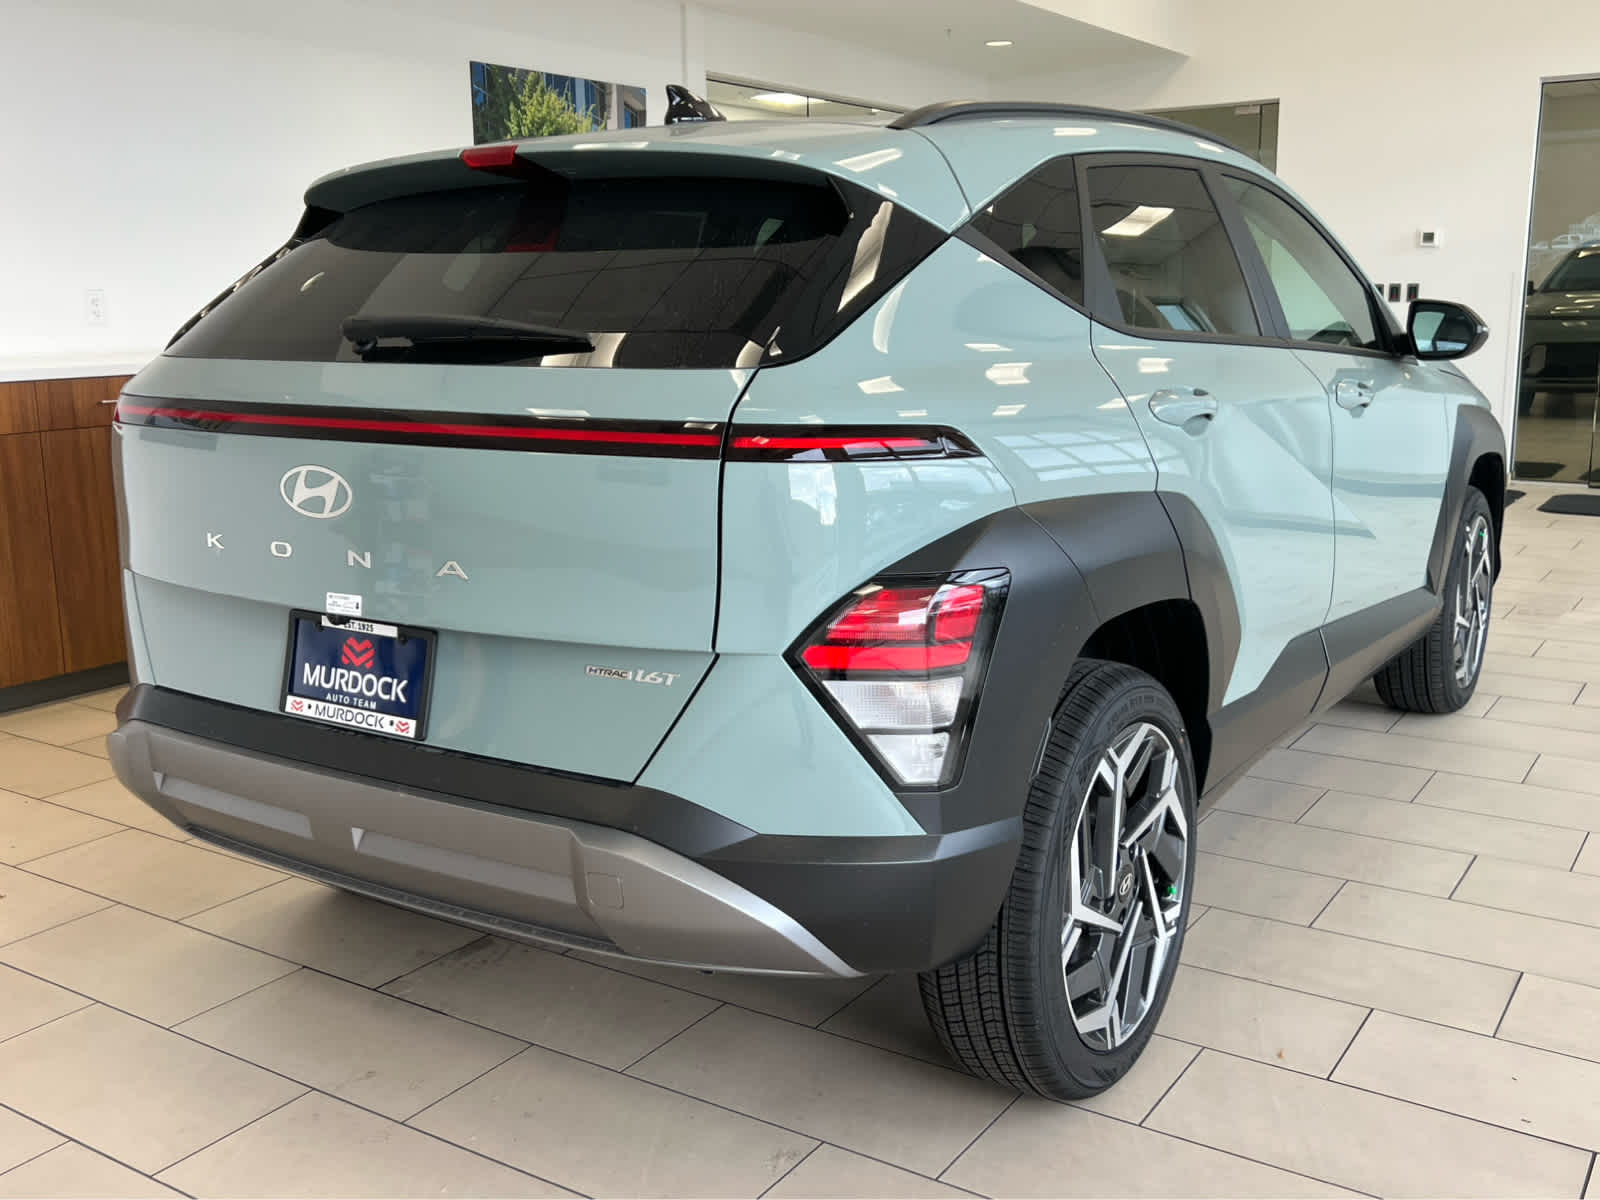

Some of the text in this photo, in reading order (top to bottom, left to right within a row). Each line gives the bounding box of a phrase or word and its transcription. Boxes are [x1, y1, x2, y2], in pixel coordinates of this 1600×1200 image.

[303, 662, 408, 703] MURDOCK
[586, 666, 630, 680] HTRAC
[326, 693, 377, 710] AUTO TEAM
[314, 703, 385, 728] MURDOCK
